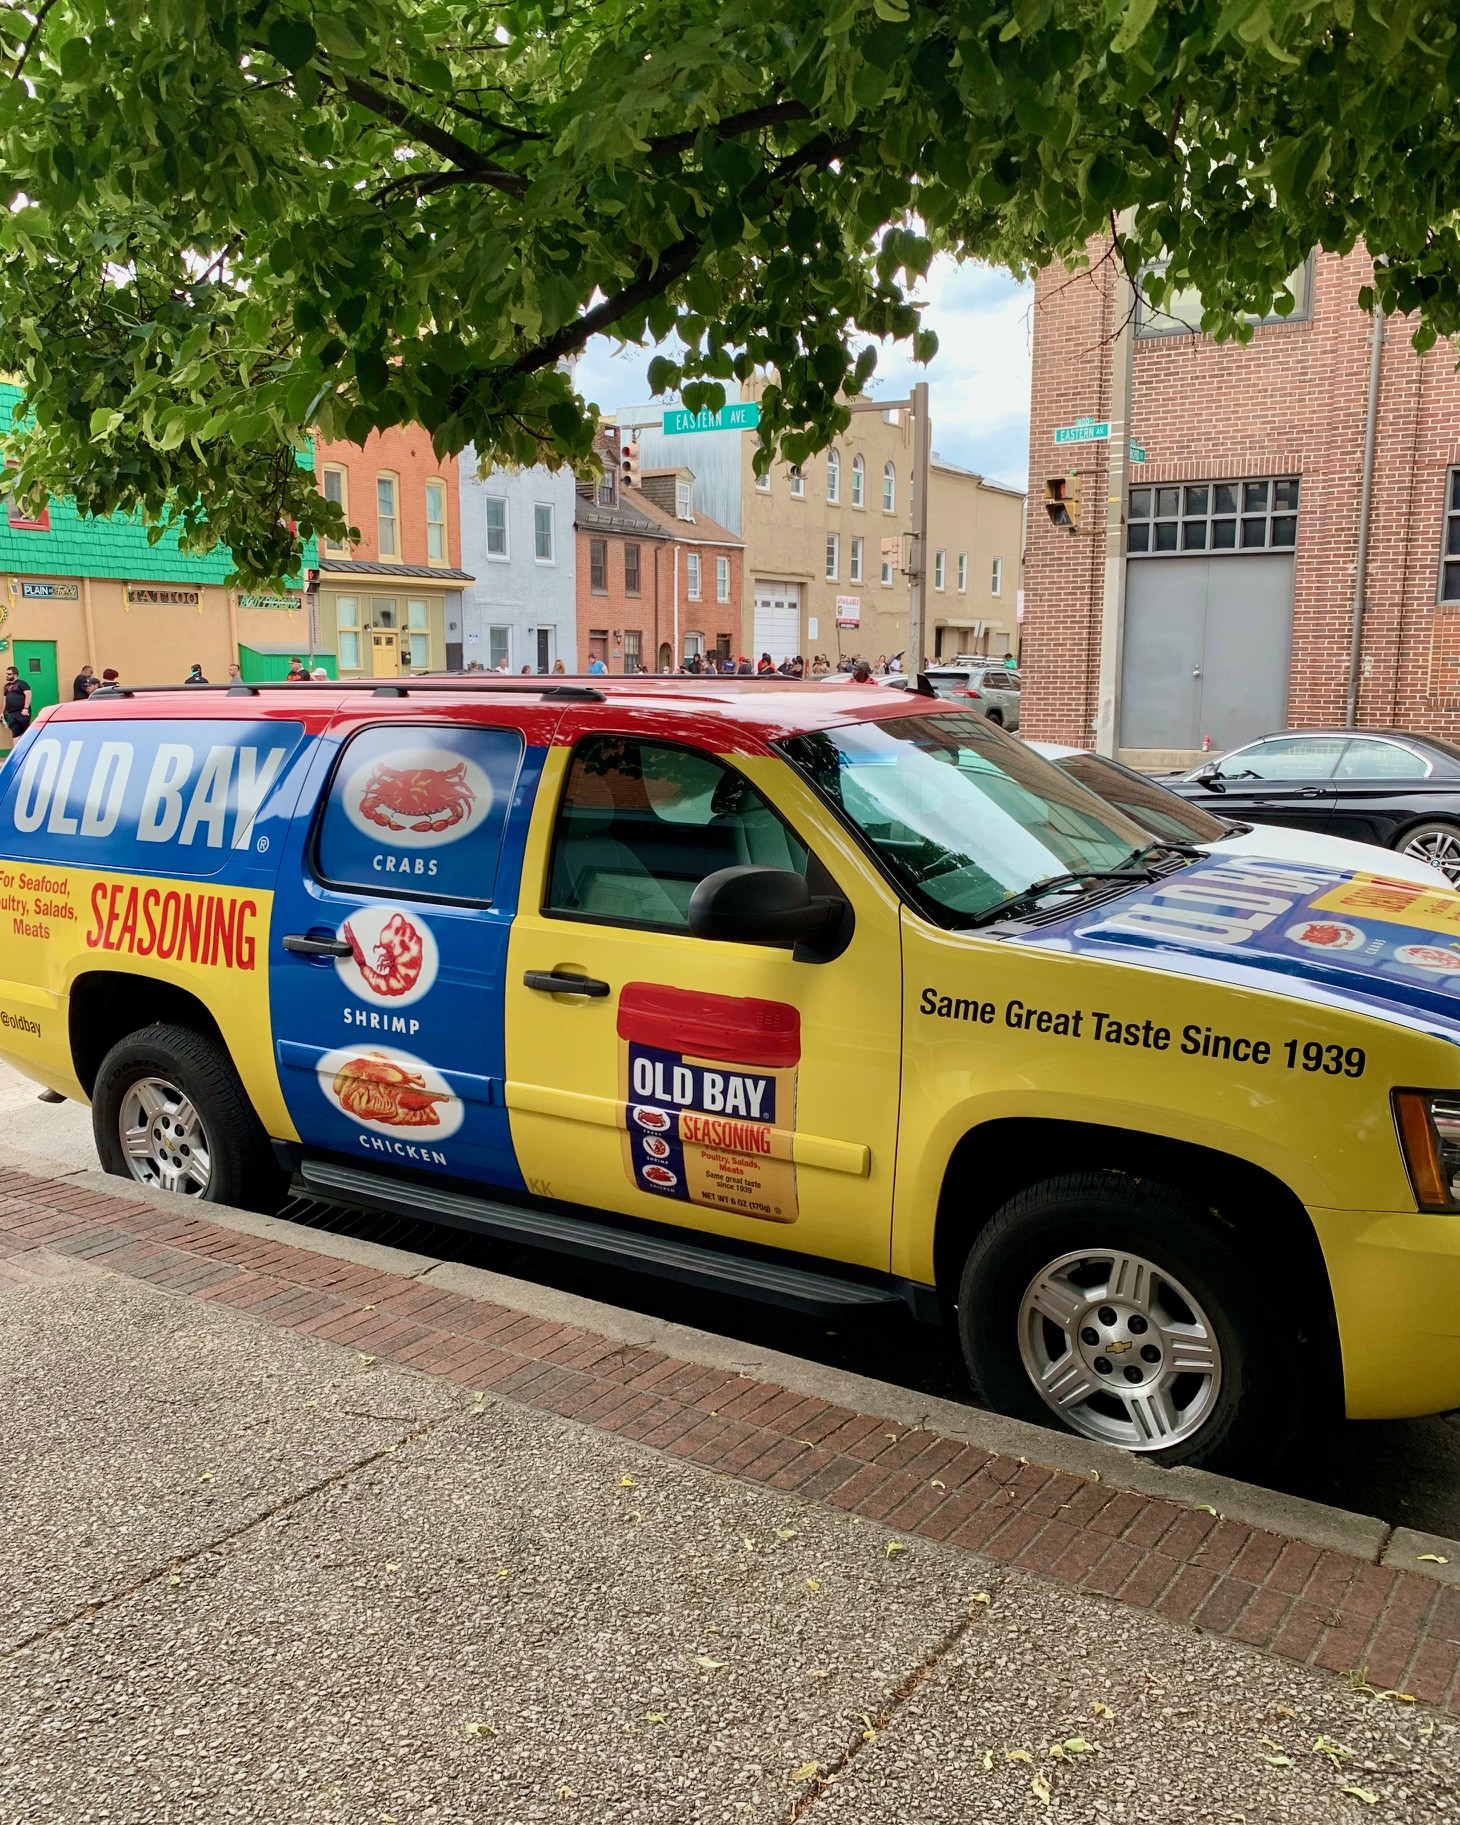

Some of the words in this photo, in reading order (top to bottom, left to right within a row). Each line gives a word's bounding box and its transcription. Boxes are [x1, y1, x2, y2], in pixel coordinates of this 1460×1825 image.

[676, 409, 722, 431] EASTERN
[1060, 427, 1094, 442] EASTERN
[24, 585, 48, 595] PLAIN
[132, 590, 198, 604] TATTOO
[13, 738, 134, 838] OLD
[136, 743, 286, 851] BAY
[372, 854, 439, 876] CRABS
[18, 873, 70, 899] Seafood,
[0, 894, 29, 917] ultry,
[34, 898, 78, 924] Salads,
[1104, 884, 1293, 944] OLD
[13, 918, 50, 940] Meats
[86, 881, 257, 971] SEASONING
[1365, 938, 1387, 955] CRABS
[1, 1011, 41, 1038] @oldbay
[343, 1007, 420, 1035] SHRIMP
[920, 987, 996, 1024] Same
[1005, 1000, 1083, 1038] Great
[1091, 1012, 1171, 1050] Taste
[1180, 1024, 1271, 1064] Since
[1283, 1038, 1366, 1078] 1939
[633, 1057, 693, 1106] OLD
[703, 1072, 767, 1118] BAY
[683, 1114, 771, 1154] SEASONING
[359, 1134, 447, 1166] CHICKEN
[646, 1156, 669, 1165] SHRIMP
[719, 1164, 744, 1175] Meats
[732, 1157, 761, 1170] Salads,
[529, 1177, 556, 1197] KK
[705, 1171, 724, 1180] Same
[726, 1175, 743, 1184] great
[744, 1179, 761, 1189] taste
[716, 1181, 734, 1190] since
[736, 1184, 753, 1194] 1939
[702, 1191, 716, 1200] NET
[717, 1194, 729, 1203] WT
[731, 1197, 736, 1205] 6
[737, 1199, 748, 1207] OZ
[749, 1202, 771, 1214] (170g)
